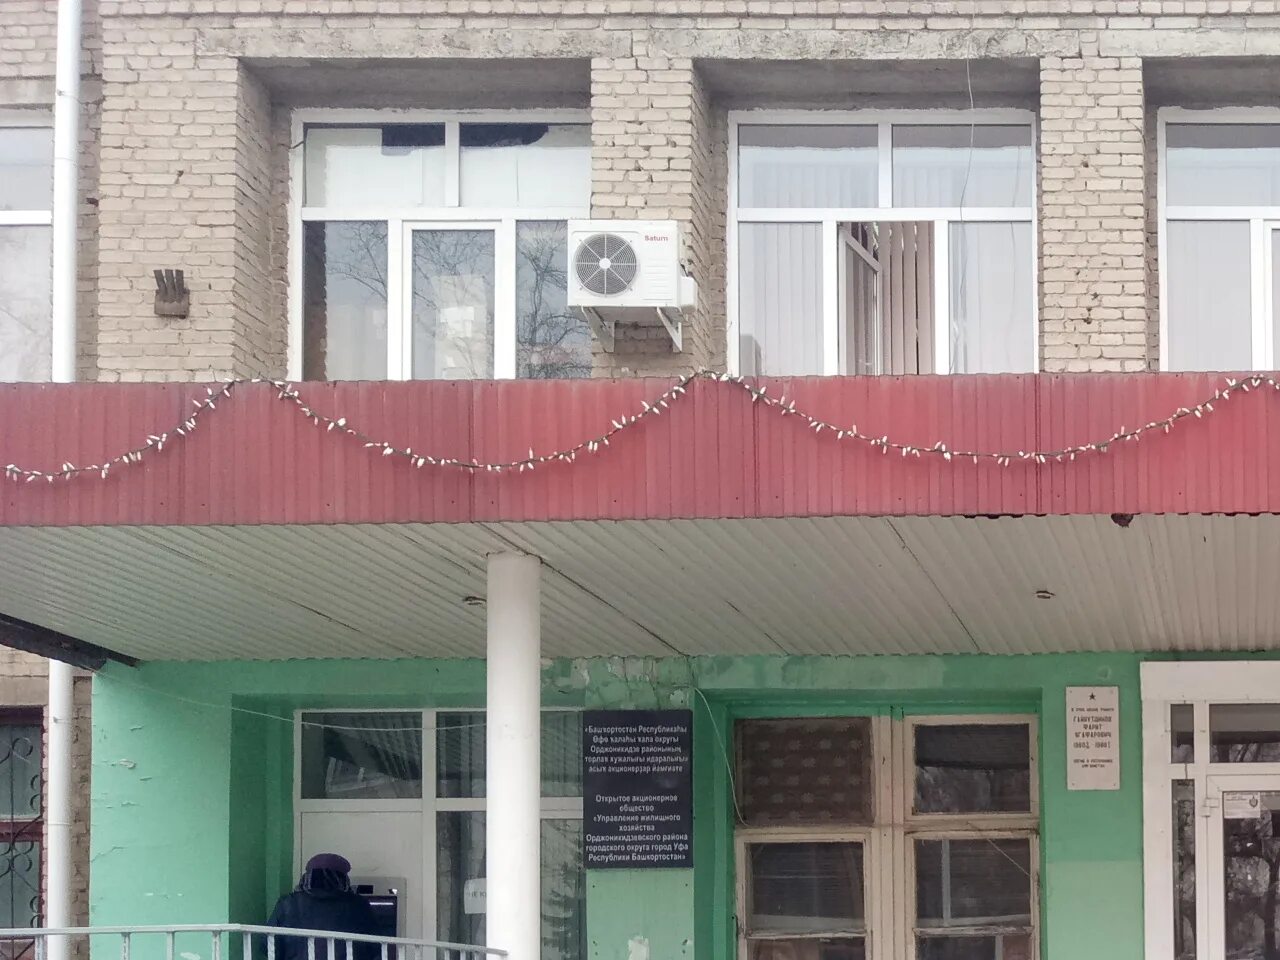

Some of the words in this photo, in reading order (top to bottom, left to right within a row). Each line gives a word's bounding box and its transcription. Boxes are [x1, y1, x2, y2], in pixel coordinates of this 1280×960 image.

[596, 795, 630, 803] Открытое
[620, 804, 654, 812] общество
[586, 834, 661, 842] Орджоникидзевского
[663, 833, 688, 842] района
[585, 844, 625, 852] городского
[674, 843, 688, 851] Уфа
[589, 853, 630, 862] Республики
